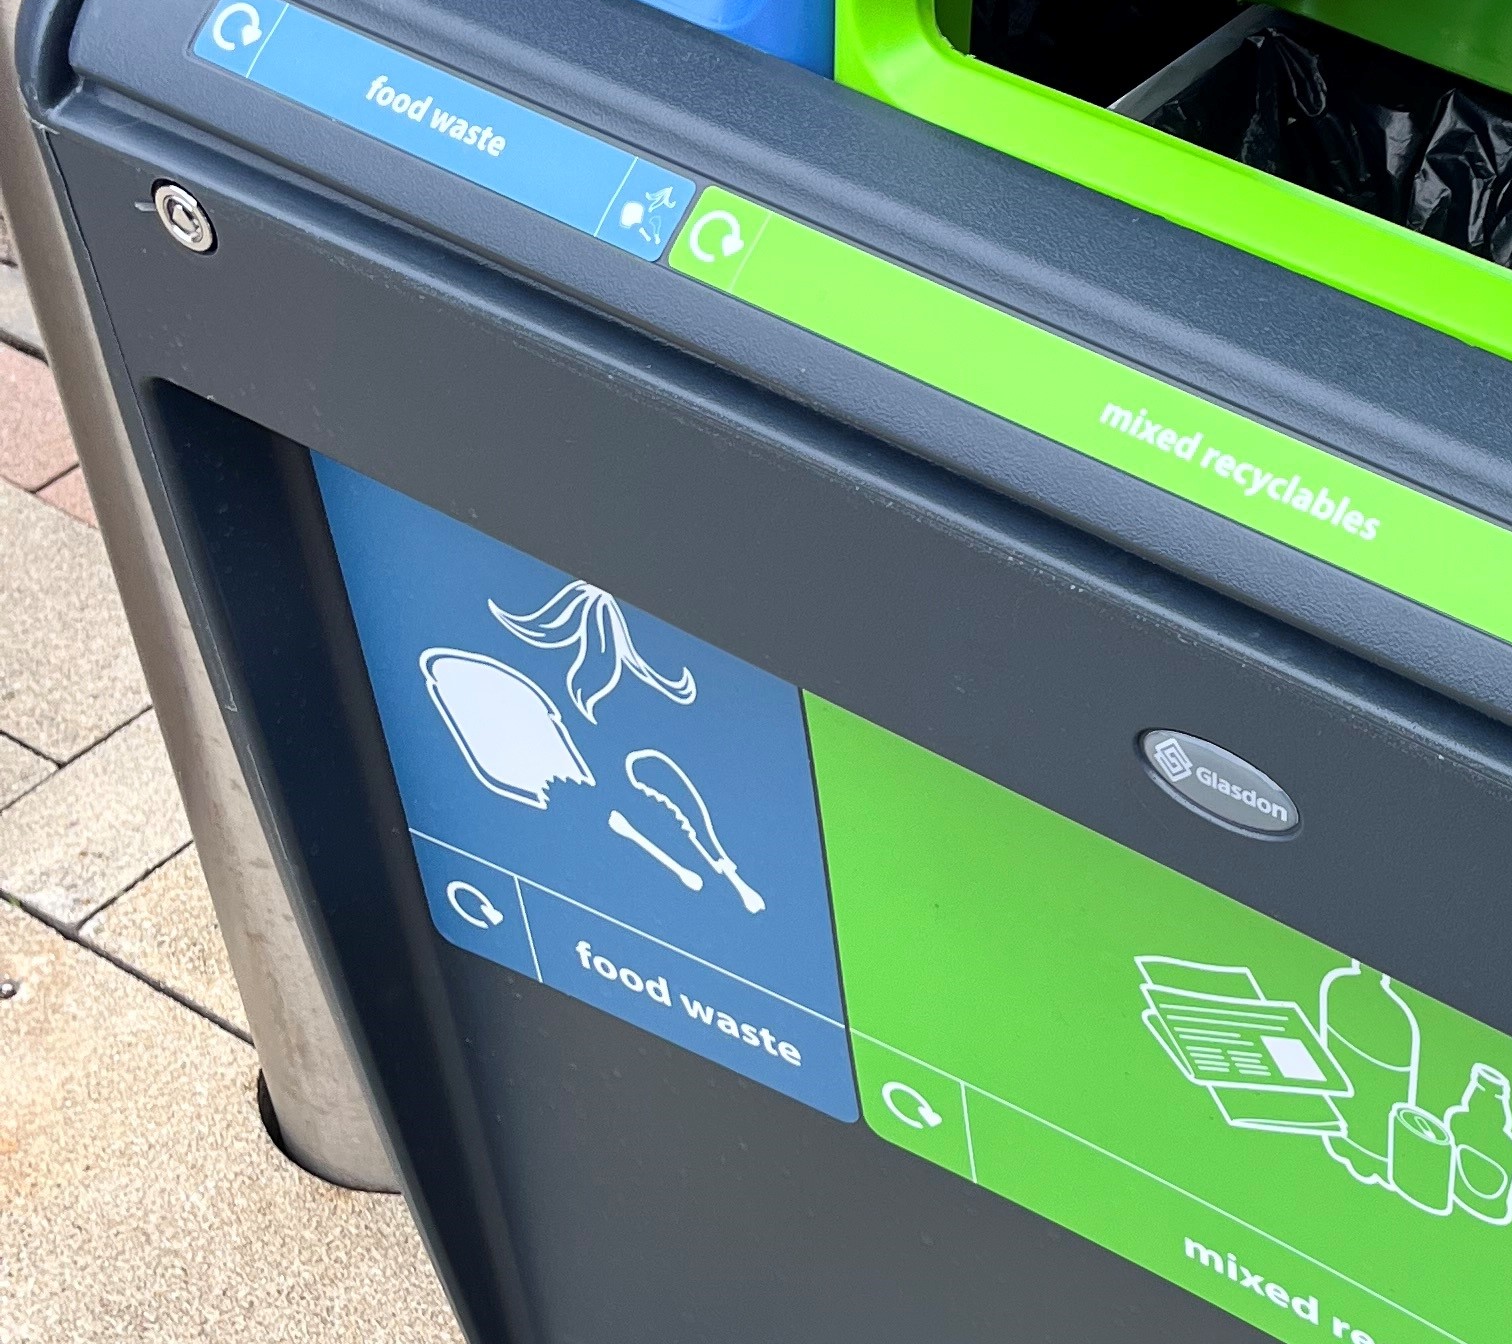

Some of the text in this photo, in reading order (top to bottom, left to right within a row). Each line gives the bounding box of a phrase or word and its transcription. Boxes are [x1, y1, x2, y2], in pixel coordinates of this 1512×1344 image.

[366, 74, 508, 157] food waste
[1099, 402, 1381, 540] mixed recyclables
[1195, 764, 1288, 823] Glasdon
[575, 940, 802, 1066] food waste
[1183, 1235, 1320, 1326] mixed
